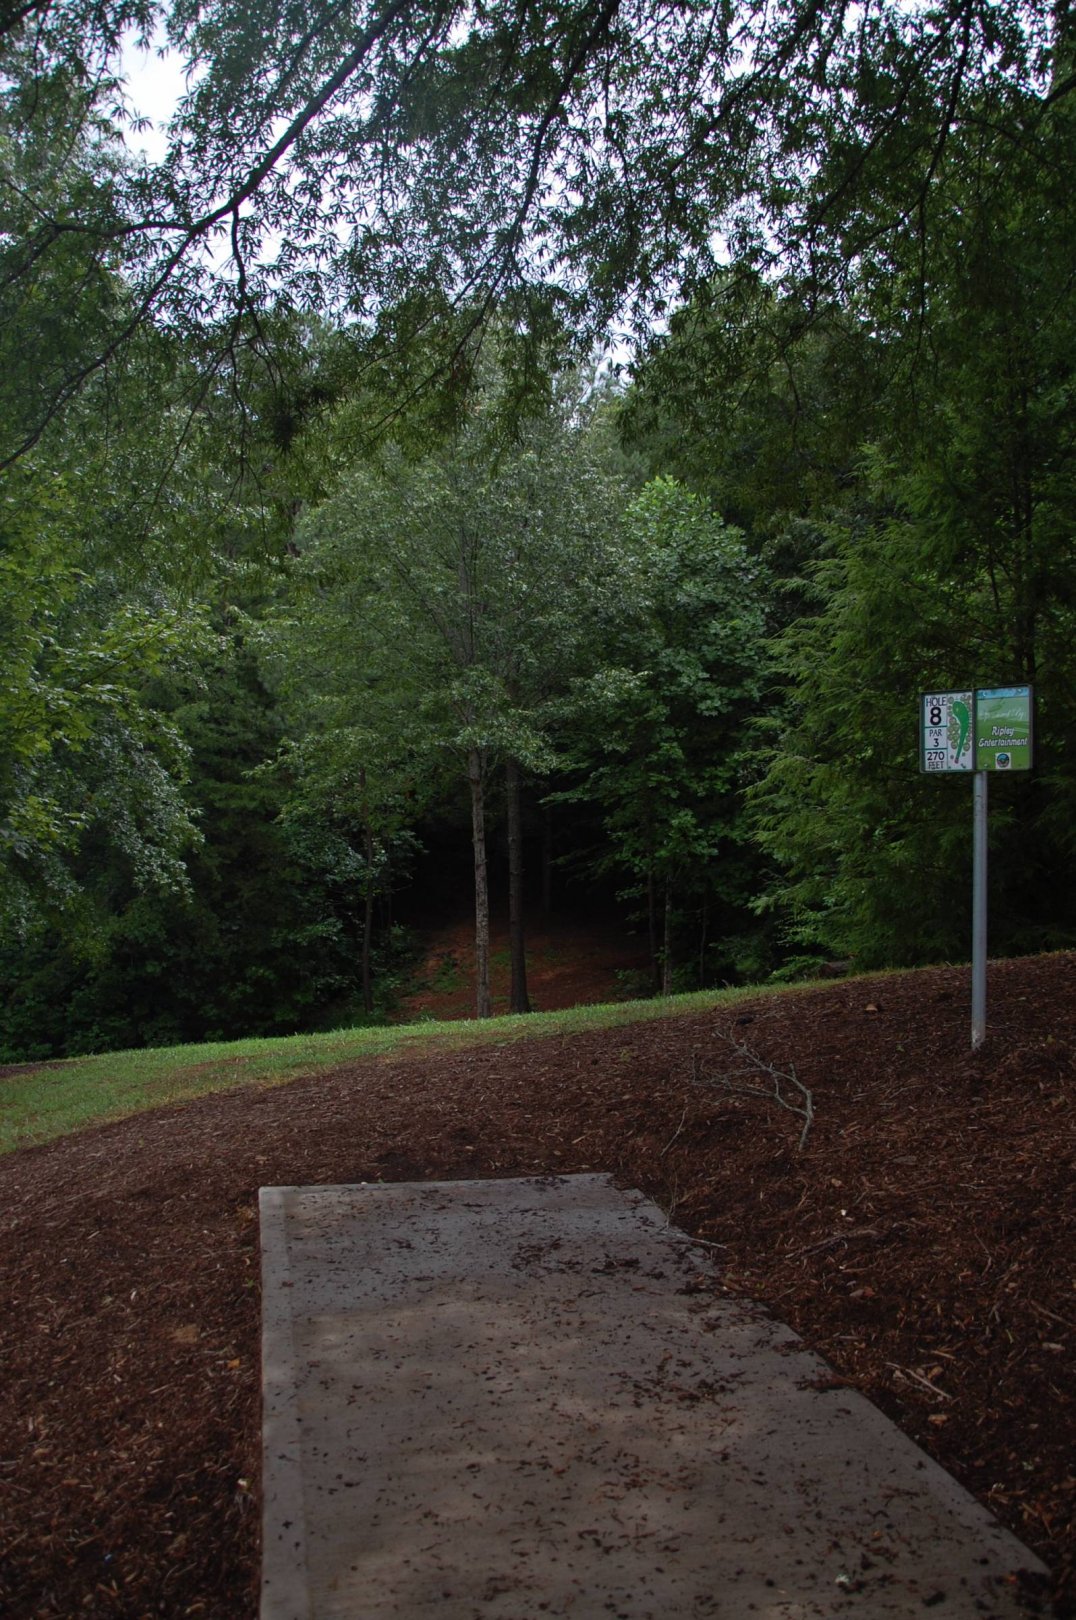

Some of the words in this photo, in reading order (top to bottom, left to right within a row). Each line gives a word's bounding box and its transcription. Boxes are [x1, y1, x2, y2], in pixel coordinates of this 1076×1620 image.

[925, 696, 947, 707] HOLE
[930, 706, 942, 726] 8
[929, 729, 942, 737] PAR
[992, 725, 1015, 736] Ripley
[933, 738, 939, 748] 3
[978, 737, 1027, 747] Entertainment
[927, 751, 945, 761] 270
[928, 761, 944, 769] FEET
